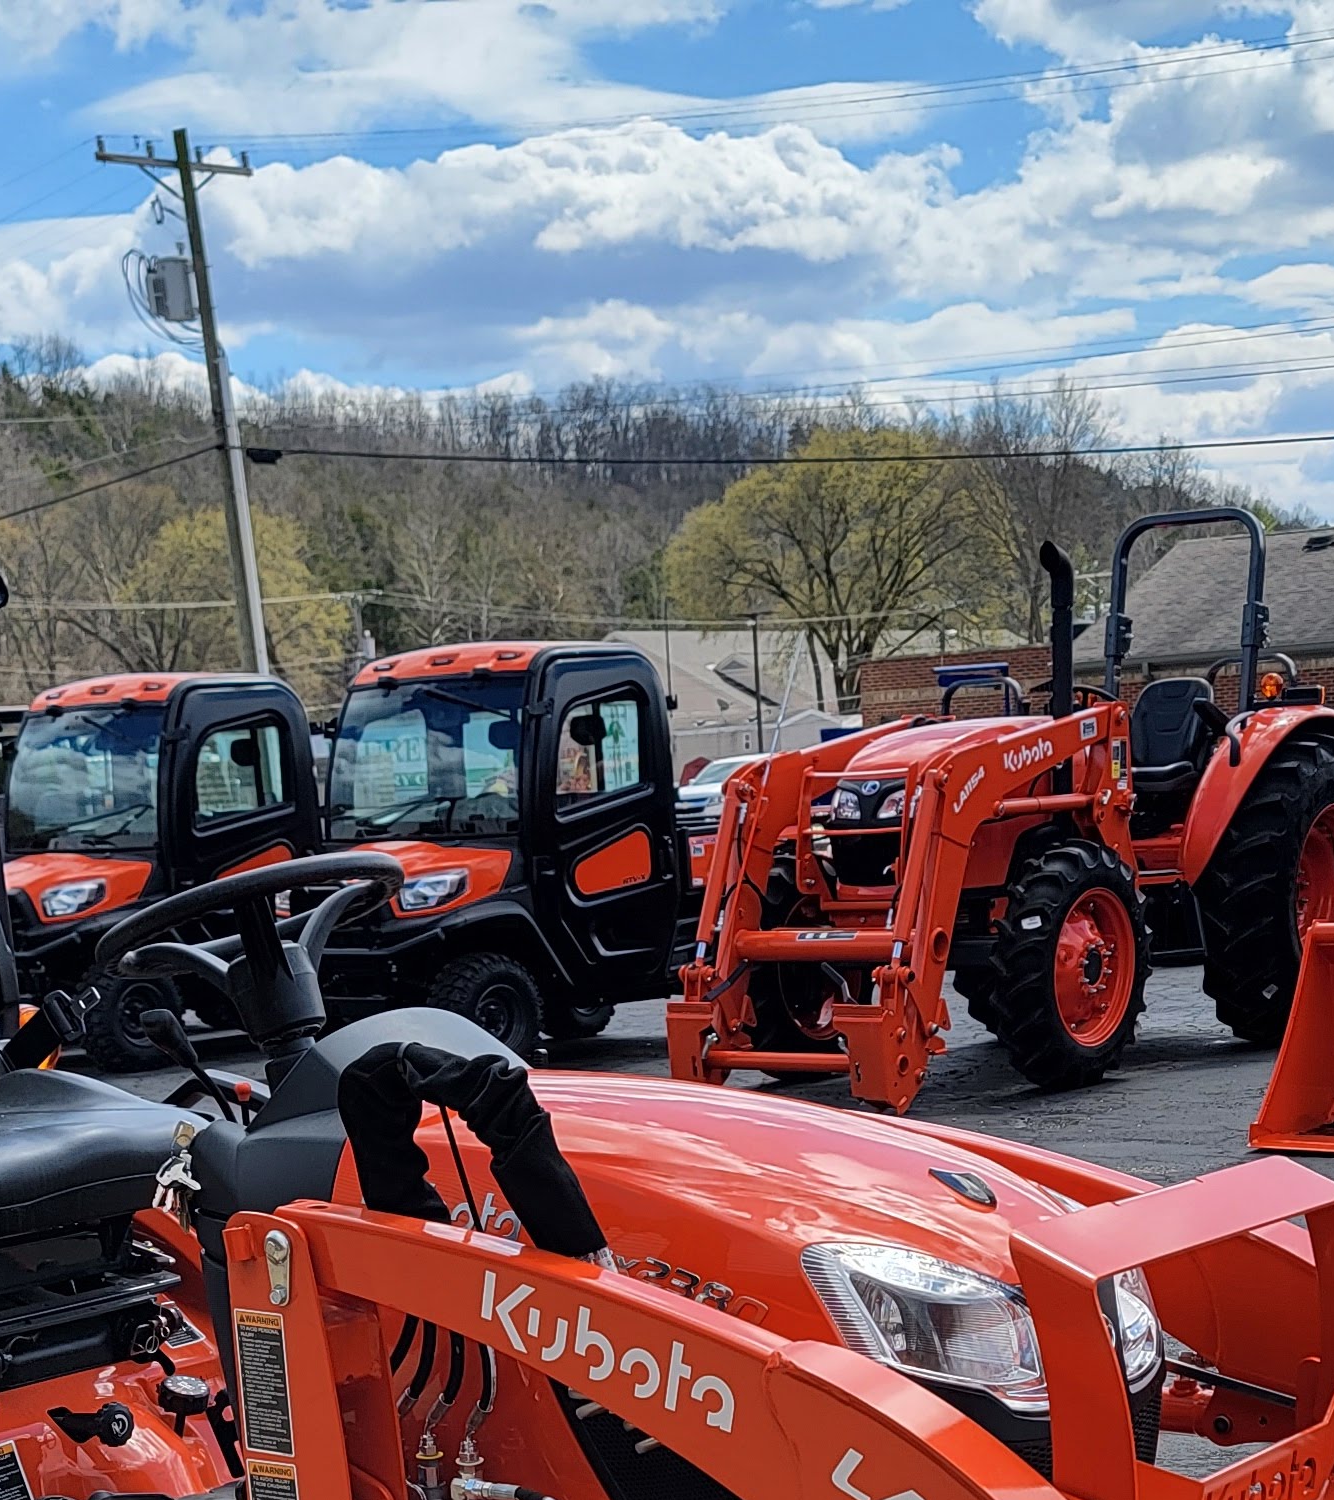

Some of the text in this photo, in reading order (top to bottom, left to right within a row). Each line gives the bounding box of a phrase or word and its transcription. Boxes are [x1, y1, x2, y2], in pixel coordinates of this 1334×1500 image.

[1003, 737, 1053, 772] Kubota
[953, 765, 986, 814] LA1154
[245, 1314, 280, 1327] WARNING
[481, 1270, 735, 1433] Kubota
[258, 1465, 292, 1477] WARNING
